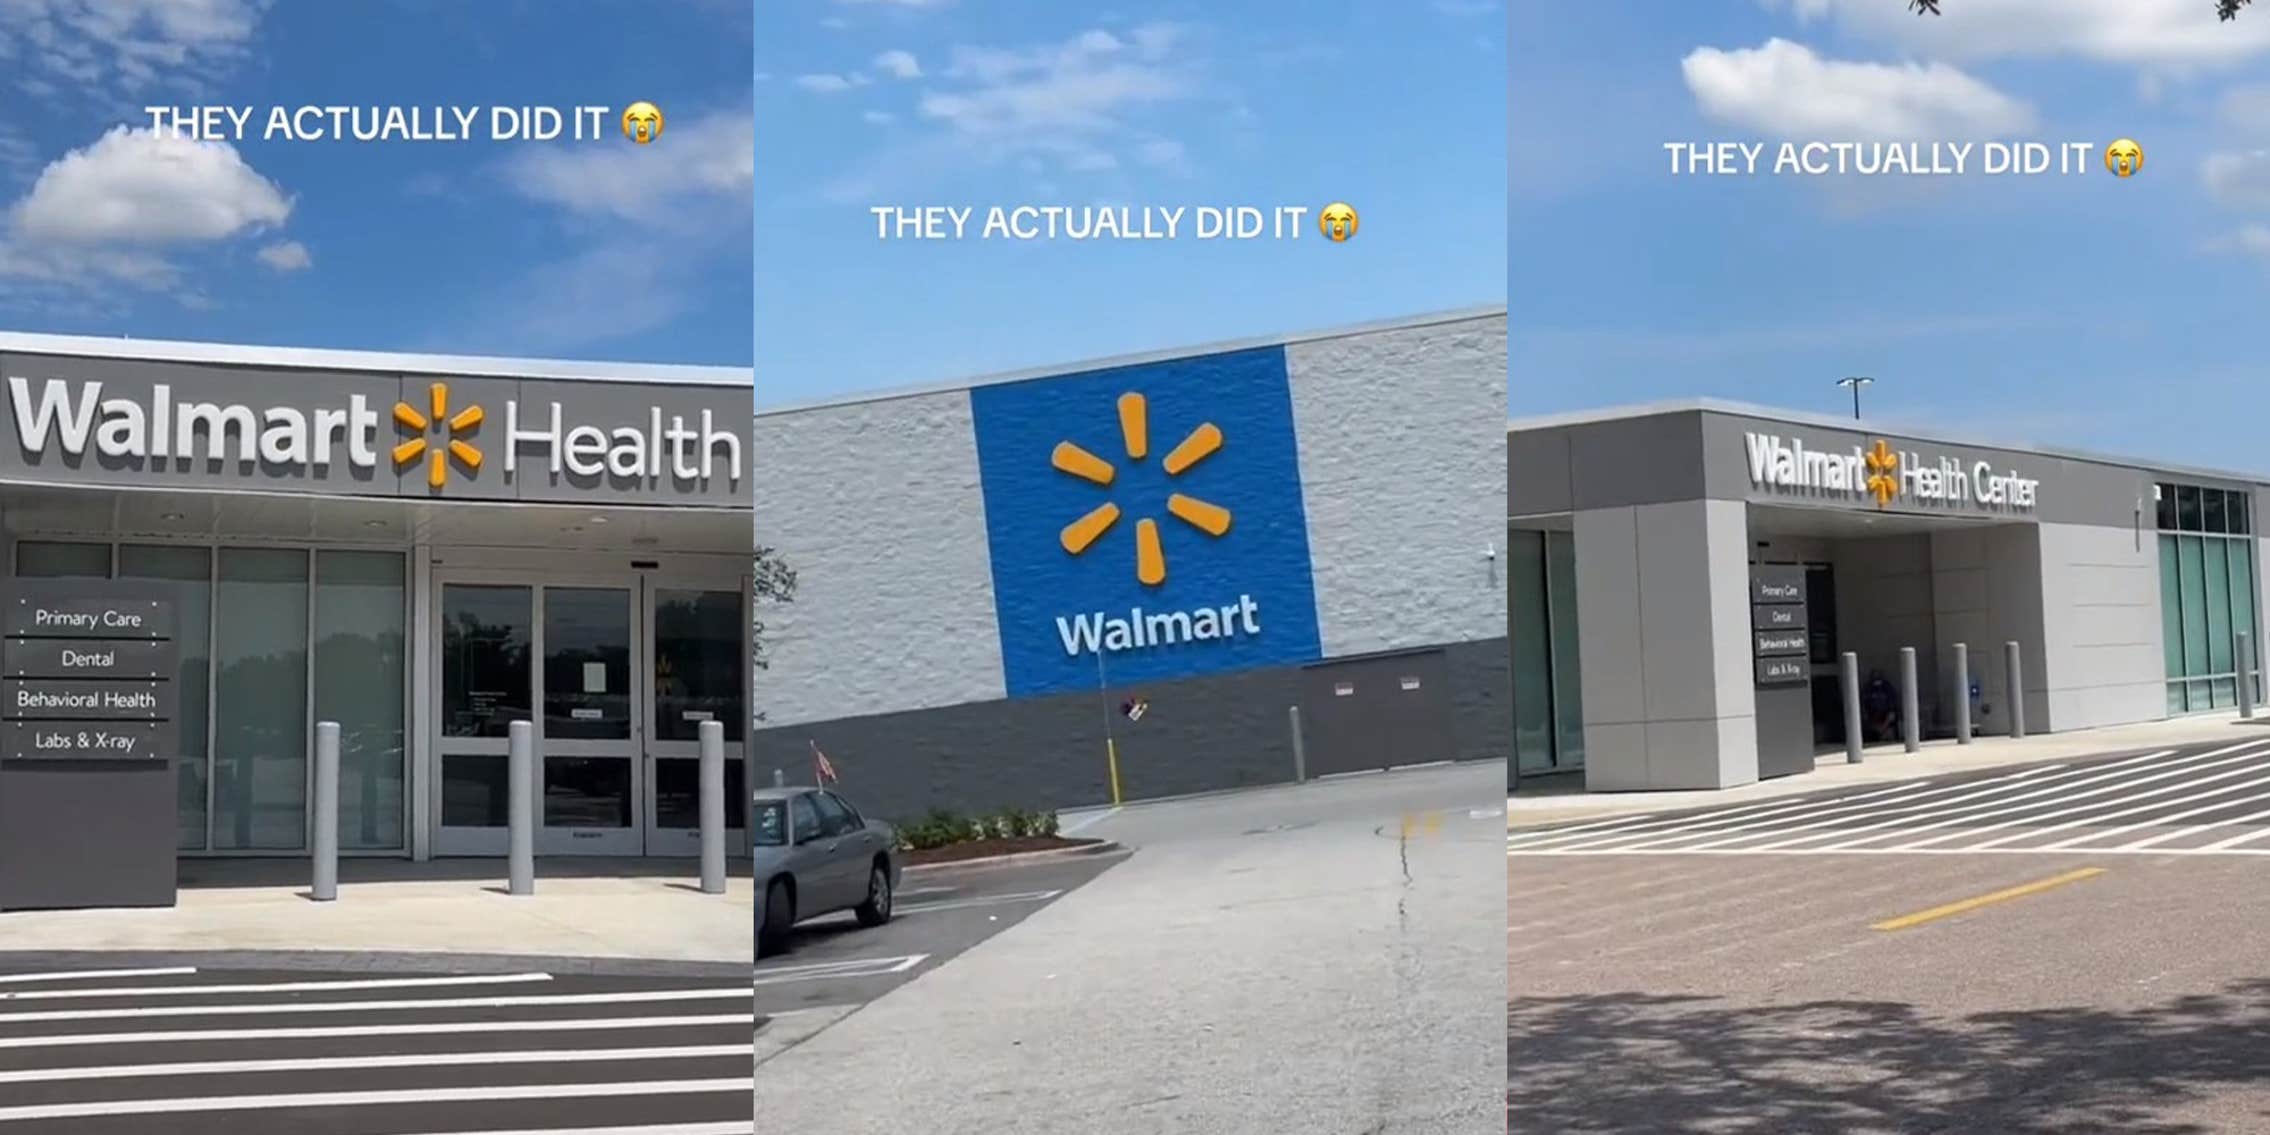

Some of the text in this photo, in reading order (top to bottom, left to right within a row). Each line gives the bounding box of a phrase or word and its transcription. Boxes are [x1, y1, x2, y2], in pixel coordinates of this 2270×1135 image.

[8, 375, 742, 480] Walmart Health
[1745, 432, 2039, 506] Walmart Health Center
[35, 609, 142, 630] Primary Care
[1056, 594, 1260, 657] Walmart
[62, 650, 114, 667] Dental
[17, 690, 156, 707] Behavioral Health
[35, 731, 136, 753] Labs & X-ray
